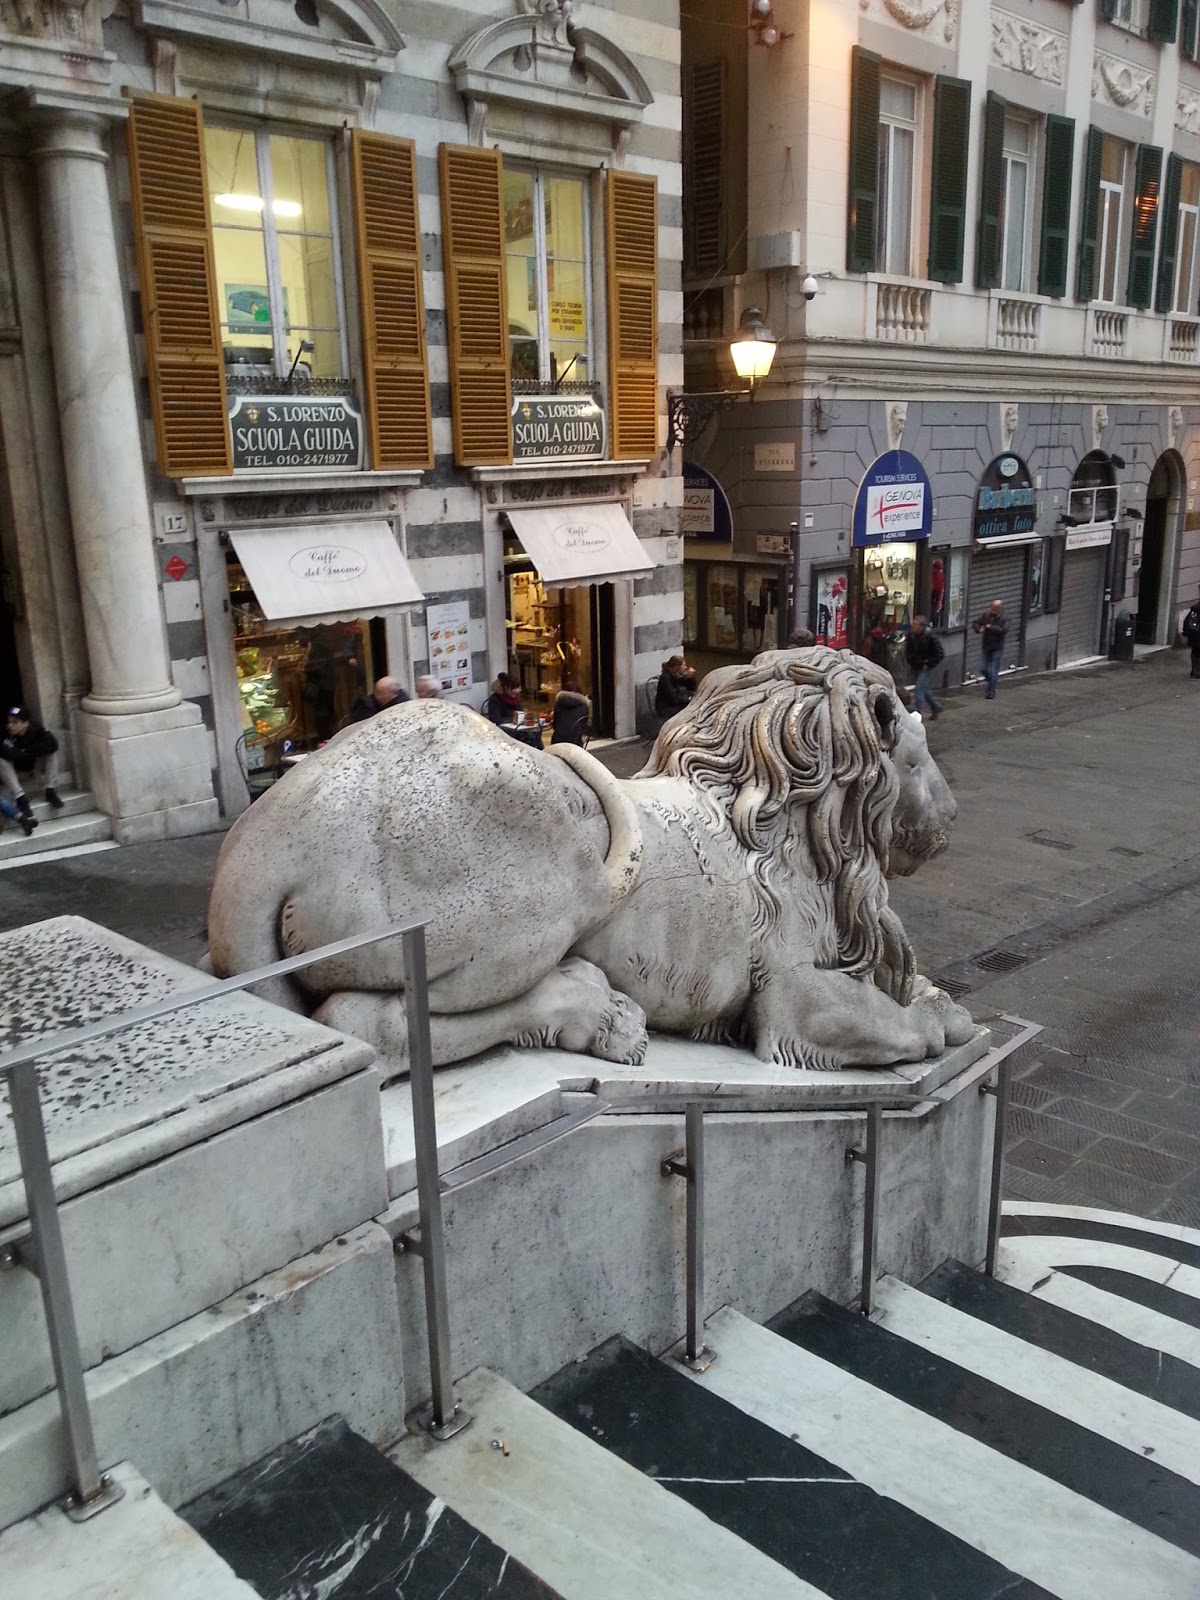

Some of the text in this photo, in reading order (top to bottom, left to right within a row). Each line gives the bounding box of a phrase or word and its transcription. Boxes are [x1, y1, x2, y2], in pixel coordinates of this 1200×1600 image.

[267, 406, 346, 422] S. LORENZO
[537, 404, 593, 418] S. LORENZO
[236, 427, 355, 452] SCUOLA GUIDA
[515, 421, 600, 444] SCUOLA GUIDA
[520, 443, 596, 456] TEL. 010-2471977
[245, 453, 349, 466] TEL. 010-2471977
[875, 473, 917, 483] TOURISM SERVICES
[684, 494, 711, 504] NOVA
[885, 488, 922, 502] GENOVA
[317, 495, 373, 512] Duomo
[168, 516, 182, 530] 17
[884, 510, 921, 525] experience
[979, 515, 1032, 535] ottica foto
[304, 566, 361, 577] del Duomo
